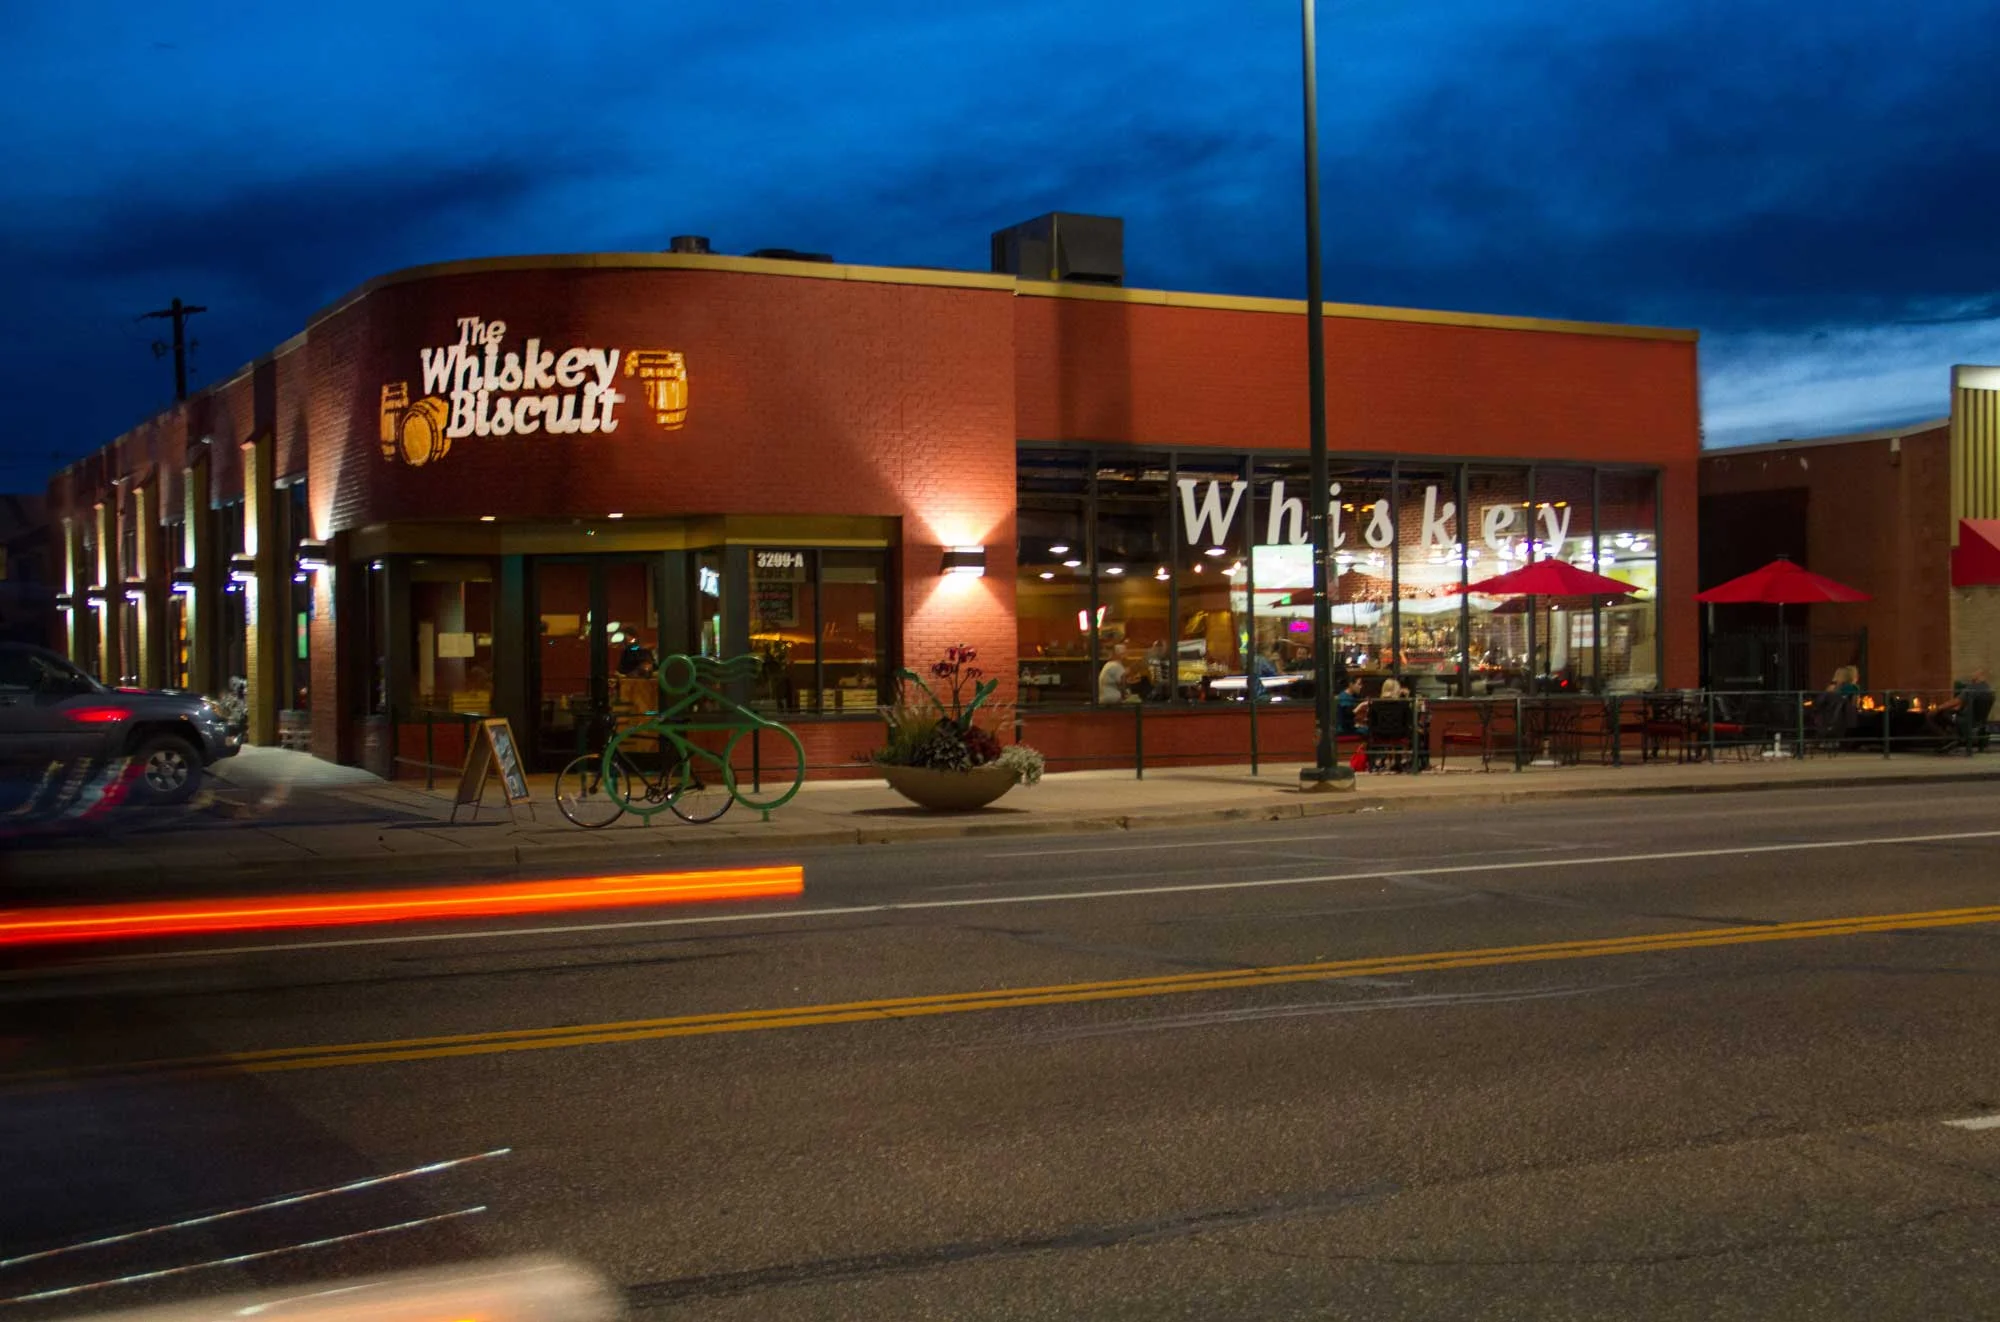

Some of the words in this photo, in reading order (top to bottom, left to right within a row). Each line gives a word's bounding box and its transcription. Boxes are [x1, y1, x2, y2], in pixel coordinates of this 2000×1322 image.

[457, 316, 506, 346] The
[421, 338, 620, 395] Whiskey
[446, 386, 626, 438] Biscuit
[1177, 479, 1571, 557] Whiskey
